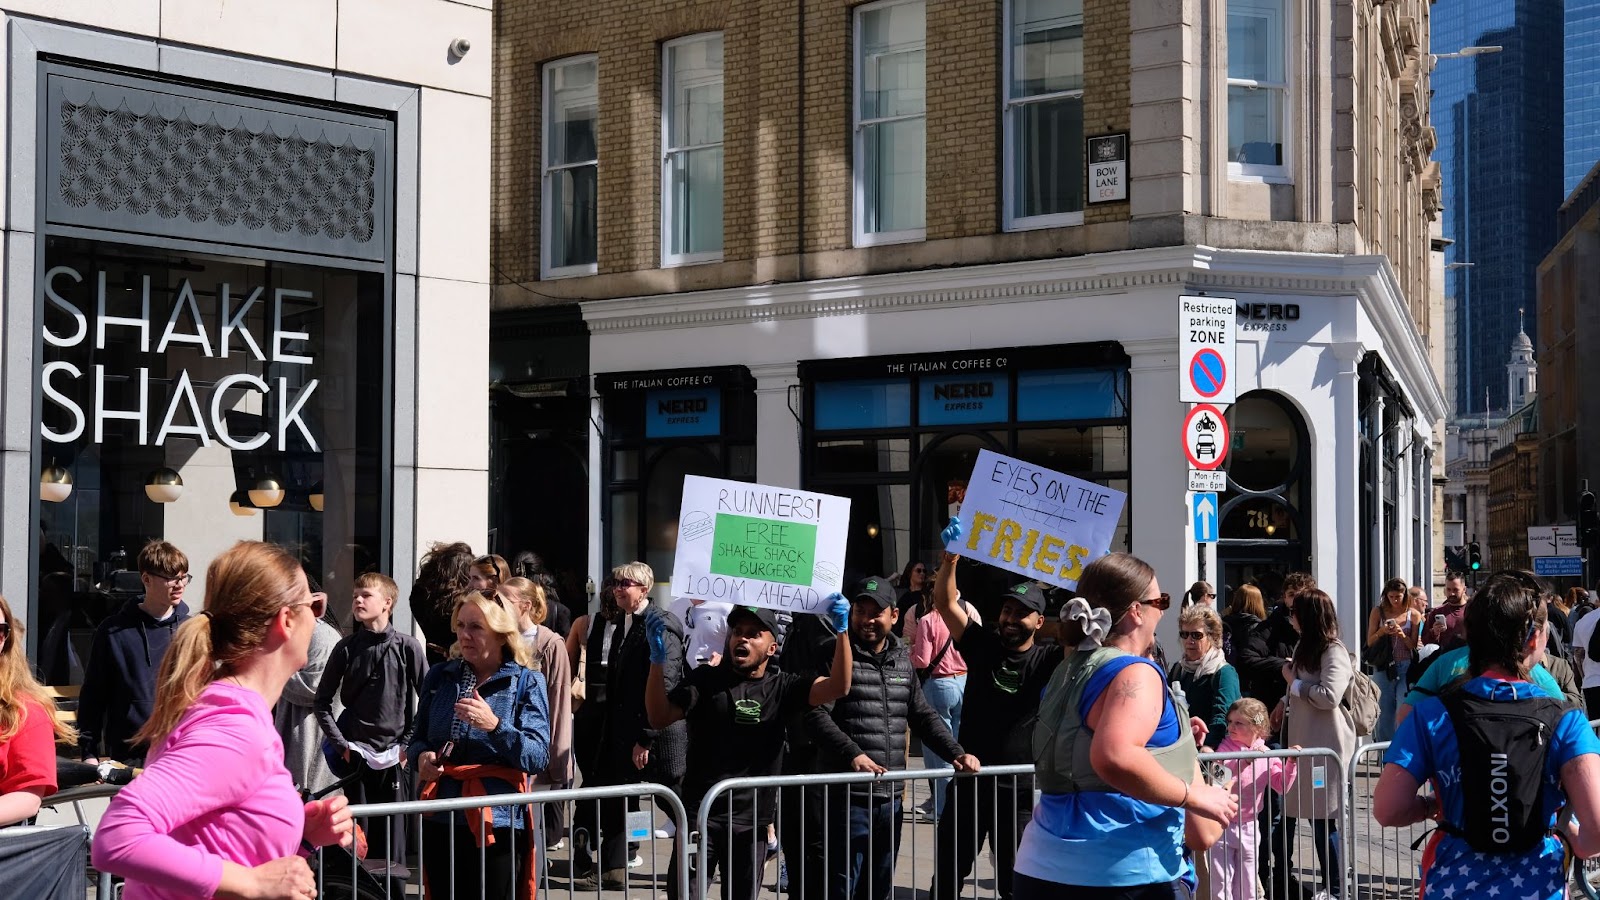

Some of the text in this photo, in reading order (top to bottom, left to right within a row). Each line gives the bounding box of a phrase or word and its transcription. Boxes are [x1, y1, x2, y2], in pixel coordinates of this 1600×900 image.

[1096, 167, 1117, 177] BOW
[1096, 177, 1118, 187] LANE
[1100, 188, 1115, 198] EC4
[43, 266, 314, 364] SHAKE
[1183, 302, 1233, 315] Restricted
[1236, 303, 1300, 320] NERO
[1190, 317, 1226, 329] parking
[1243, 323, 1287, 332] EXPRESS
[1190, 330, 1225, 344] ZONE
[887, 364, 904, 373] THE
[909, 361, 947, 372] ITALIAN
[952, 359, 991, 370] COFFEE
[613, 381, 628, 389] THE
[632, 379, 663, 389] ITALIAN
[667, 376, 699, 386] COFFEE
[934, 382, 994, 400] NERO
[41, 361, 321, 452] SHACK
[658, 398, 708, 415] NERO
[944, 402, 983, 411] EXPRESS
[667, 416, 700, 425] EXPRESS
[1194, 472, 1208, 480] Mon
[1212, 472, 1221, 480] Fri
[991, 461, 1110, 515] EYES ON THE
[718, 488, 822, 522] RUNNERS!
[1000, 491, 1076, 534] PRIZE
[1247, 509, 1269, 528] 78
[746, 522, 790, 547] FREE
[718, 542, 807, 564] SHAKE SHACK
[966, 510, 1089, 582] FRIES
[739, 560, 798, 579] BURGERS
[684, 575, 820, 611] 100M AHEAD
[1490, 753, 1510, 844] INOXTO
